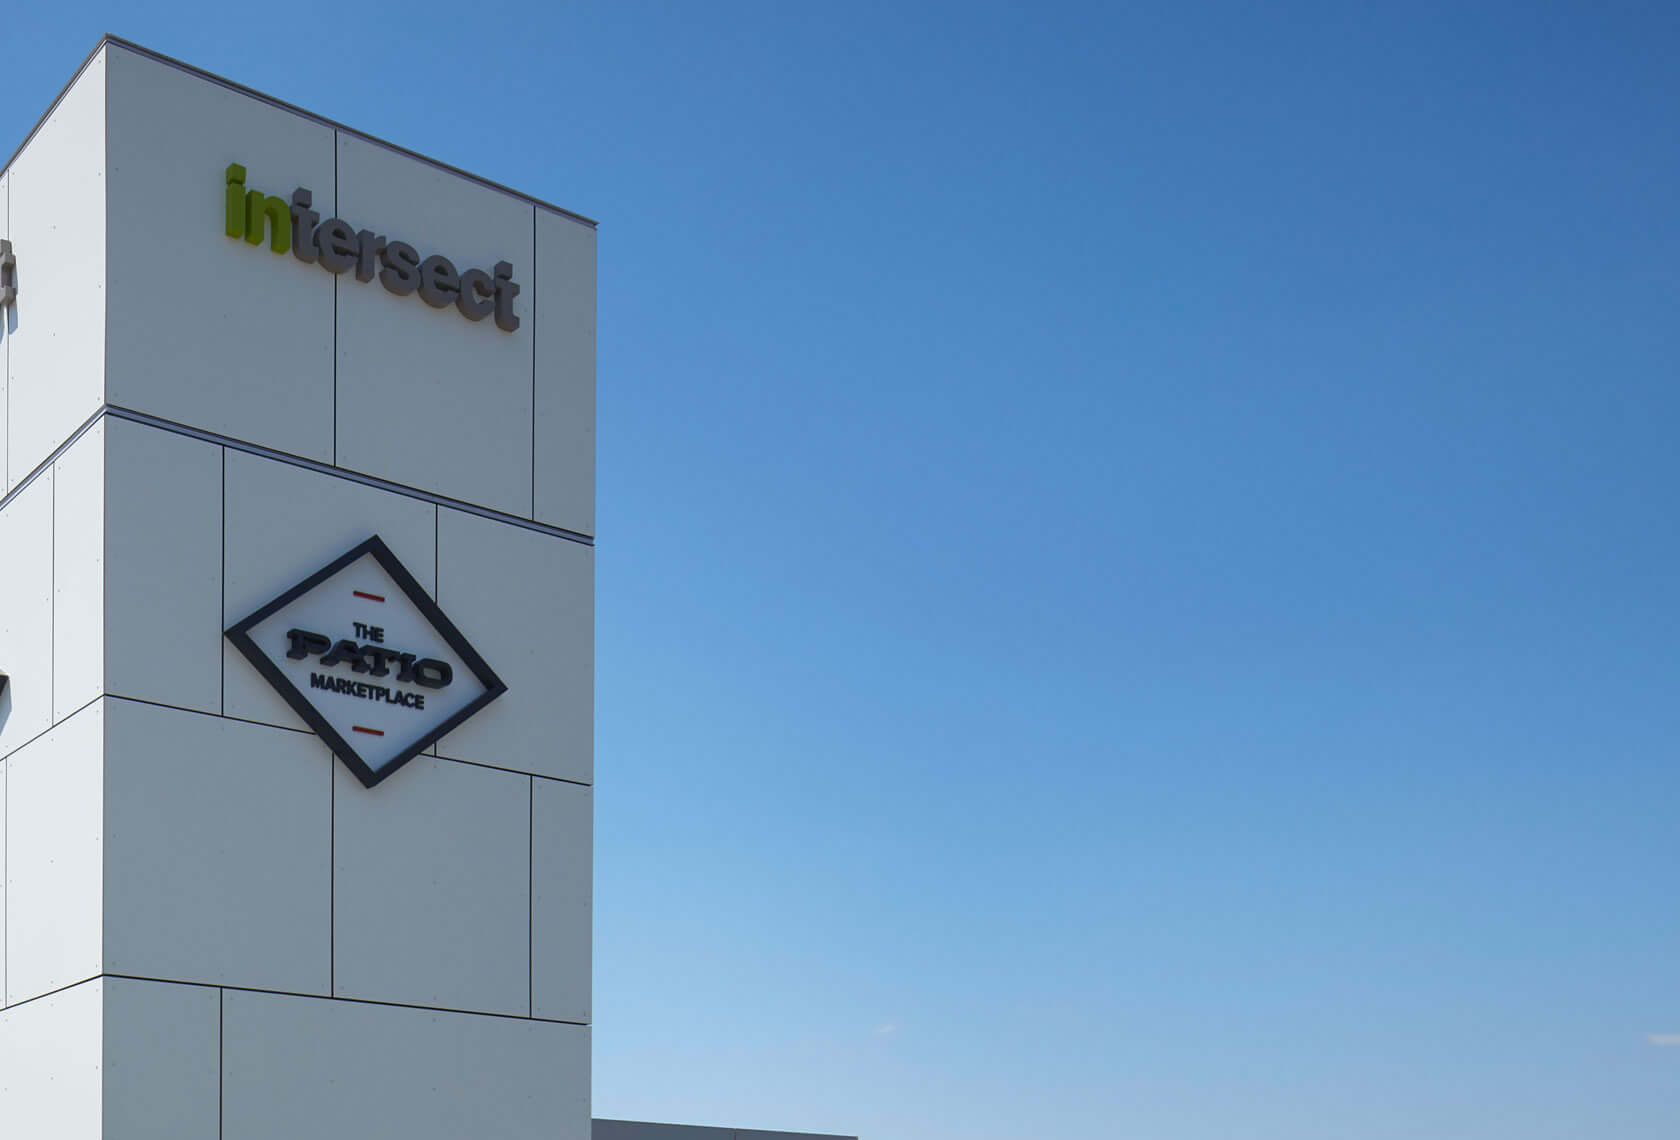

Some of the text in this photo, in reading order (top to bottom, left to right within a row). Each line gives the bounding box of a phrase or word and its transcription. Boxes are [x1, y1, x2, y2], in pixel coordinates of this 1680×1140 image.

[225, 163, 520, 333] intersect
[353, 622, 385, 643] THE
[286, 628, 453, 690] PATIO
[310, 672, 425, 710] MARKETPLACE
